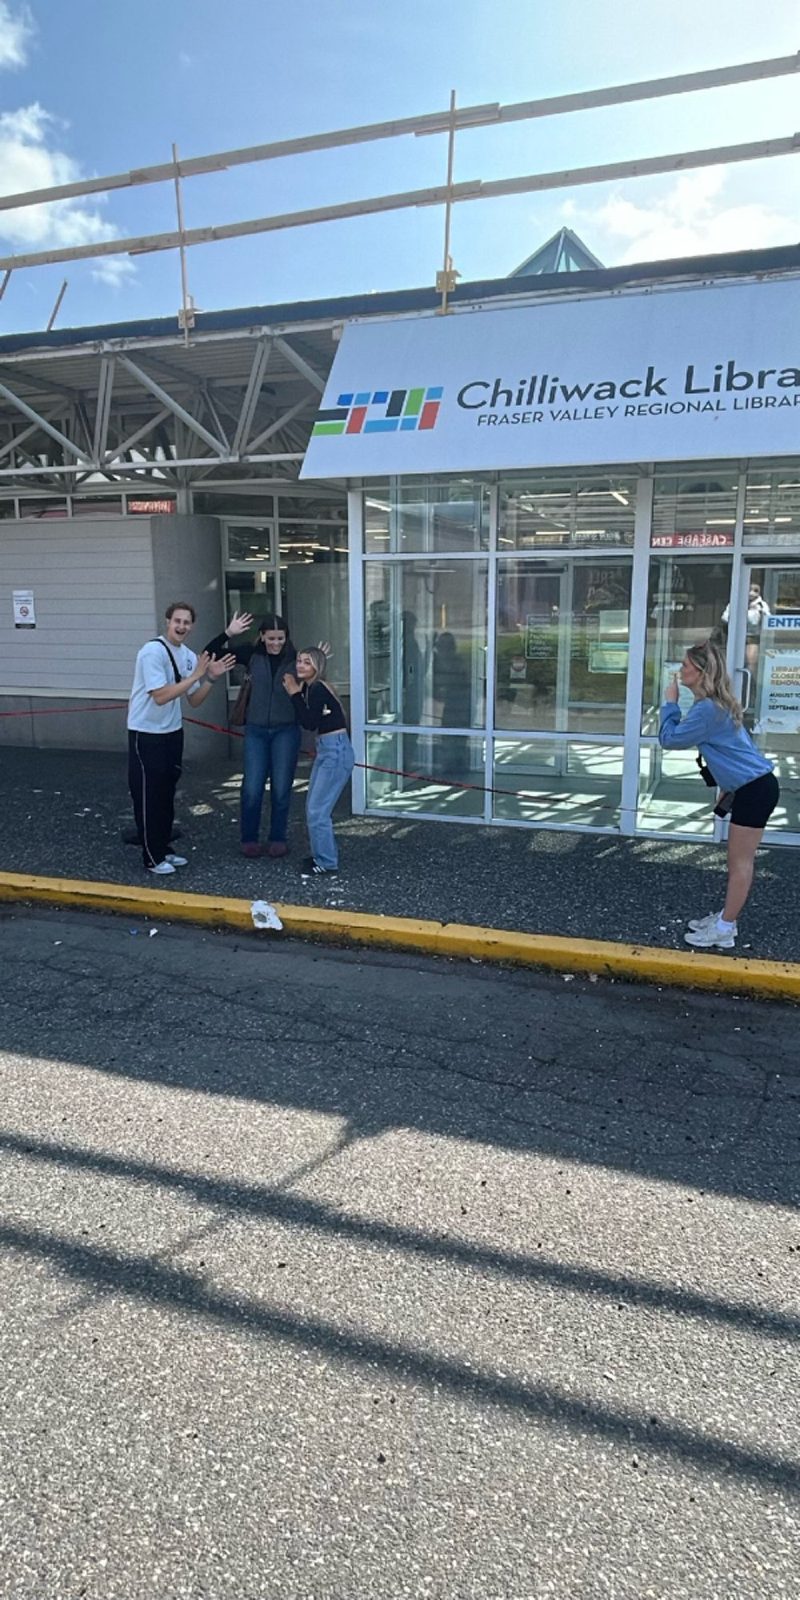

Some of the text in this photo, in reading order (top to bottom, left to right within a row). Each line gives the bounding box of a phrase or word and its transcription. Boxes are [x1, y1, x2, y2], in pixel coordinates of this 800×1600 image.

[457, 360, 800, 410] Chilliwack Libra
[477, 411, 544, 426] FRASER
[550, 405, 619, 421] VALLEY
[624, 400, 726, 417] REGIONAL
